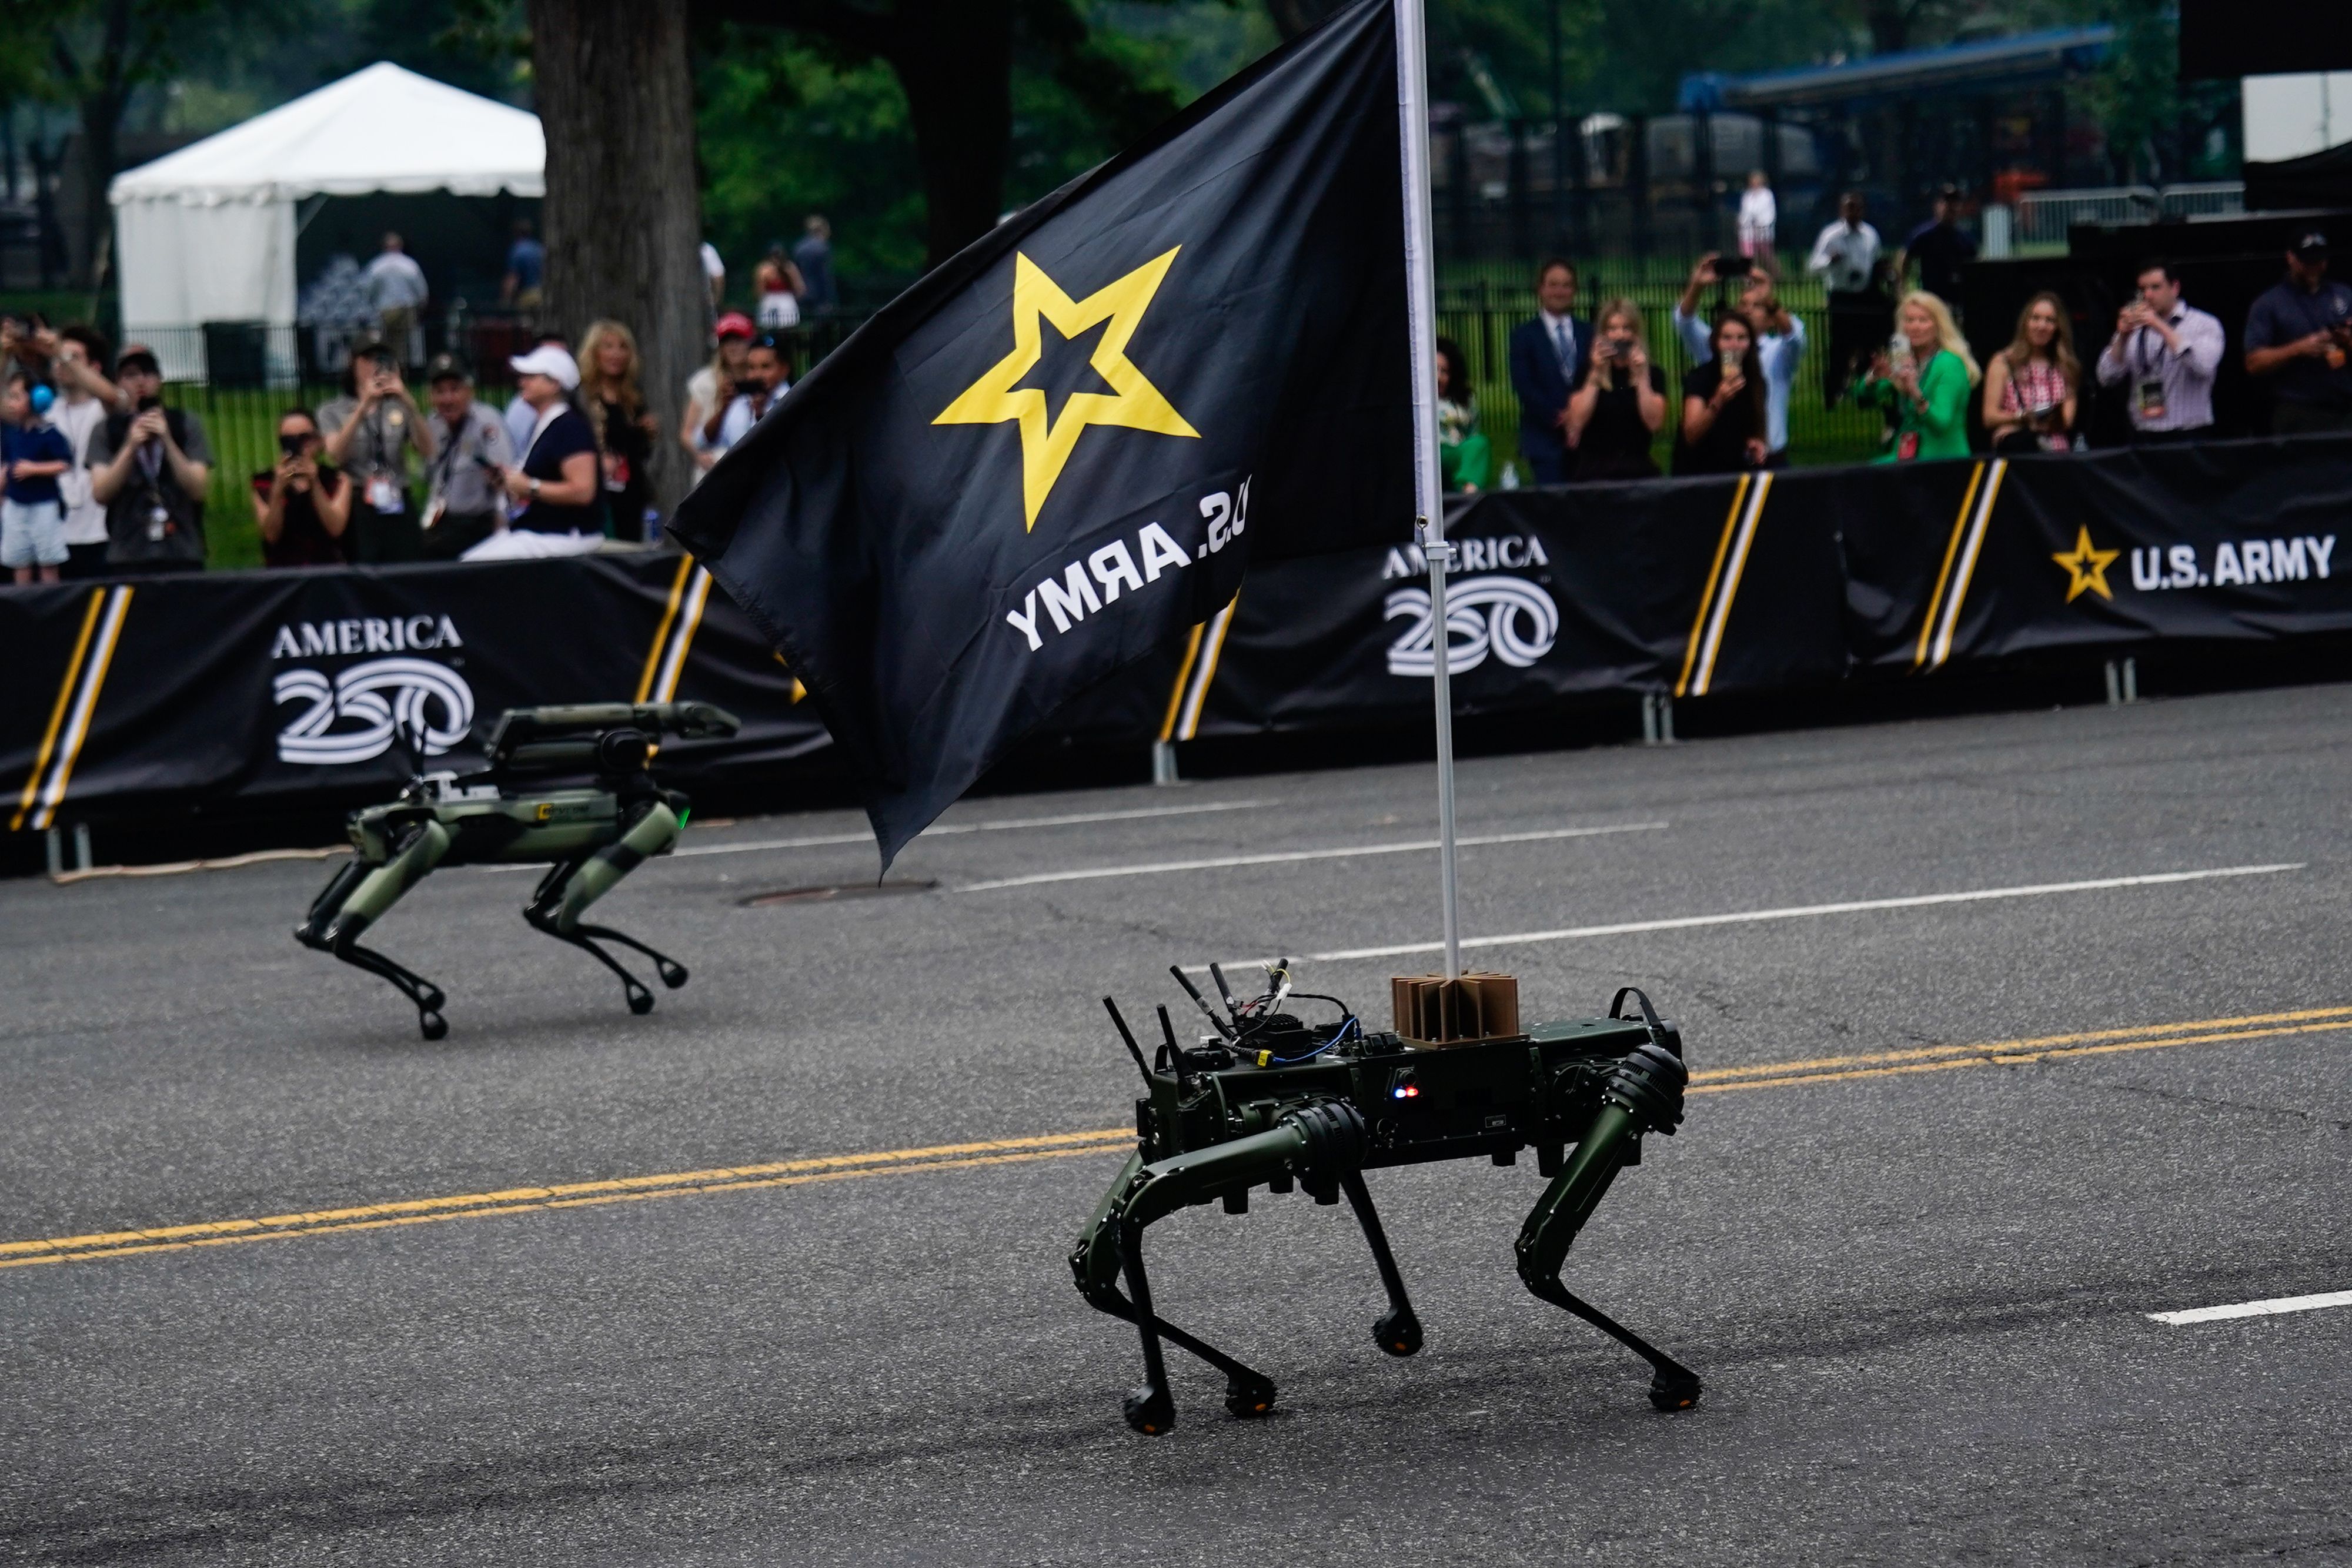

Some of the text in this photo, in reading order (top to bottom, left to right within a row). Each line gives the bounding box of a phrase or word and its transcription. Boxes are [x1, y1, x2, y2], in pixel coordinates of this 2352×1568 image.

[2130, 534, 2337, 591] U.S. ARMY
[270, 614, 464, 658] AMERICA
[1384, 576, 1559, 676] 250
[272, 657, 475, 764] 250
